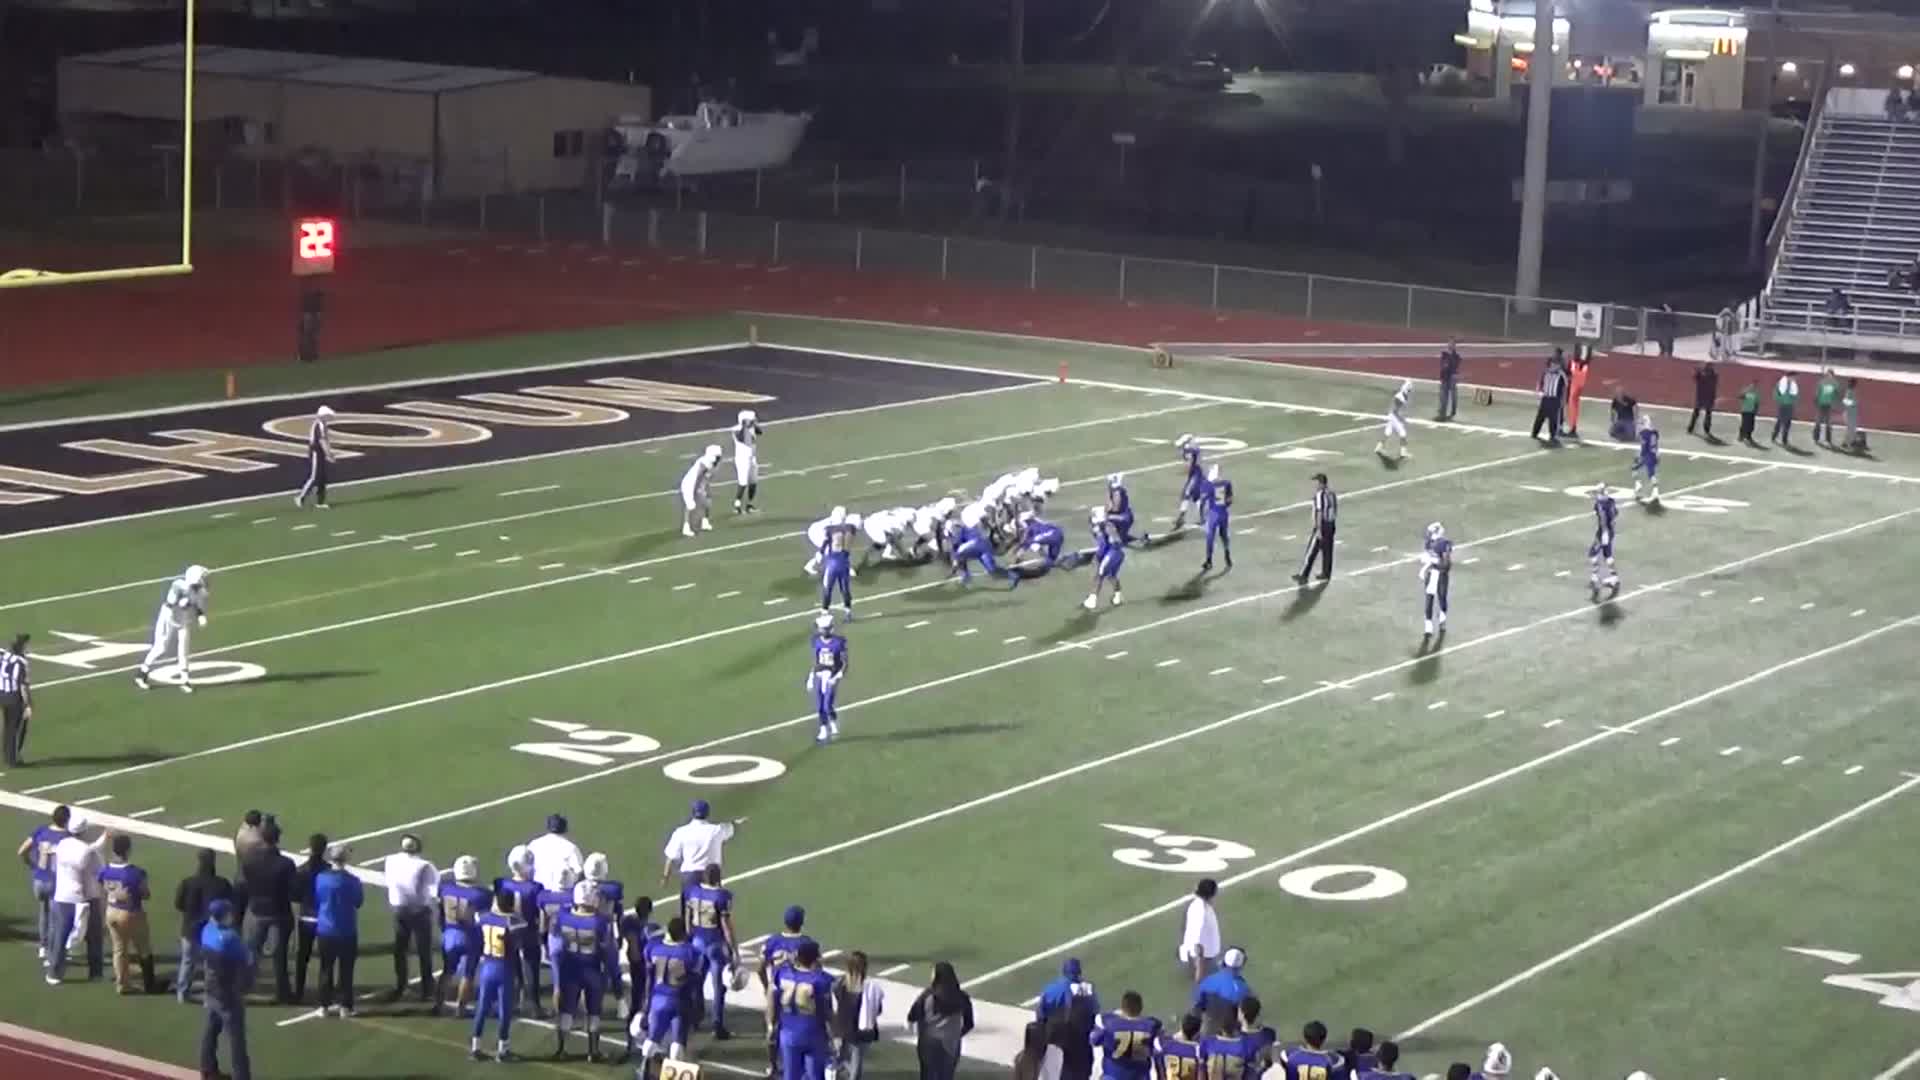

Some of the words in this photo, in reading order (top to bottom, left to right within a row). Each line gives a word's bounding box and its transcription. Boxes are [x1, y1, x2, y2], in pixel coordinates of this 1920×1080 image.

[299, 221, 333, 258] 22
[0, 377, 777, 504] LHOUN
[481, 924, 505, 957] 15
